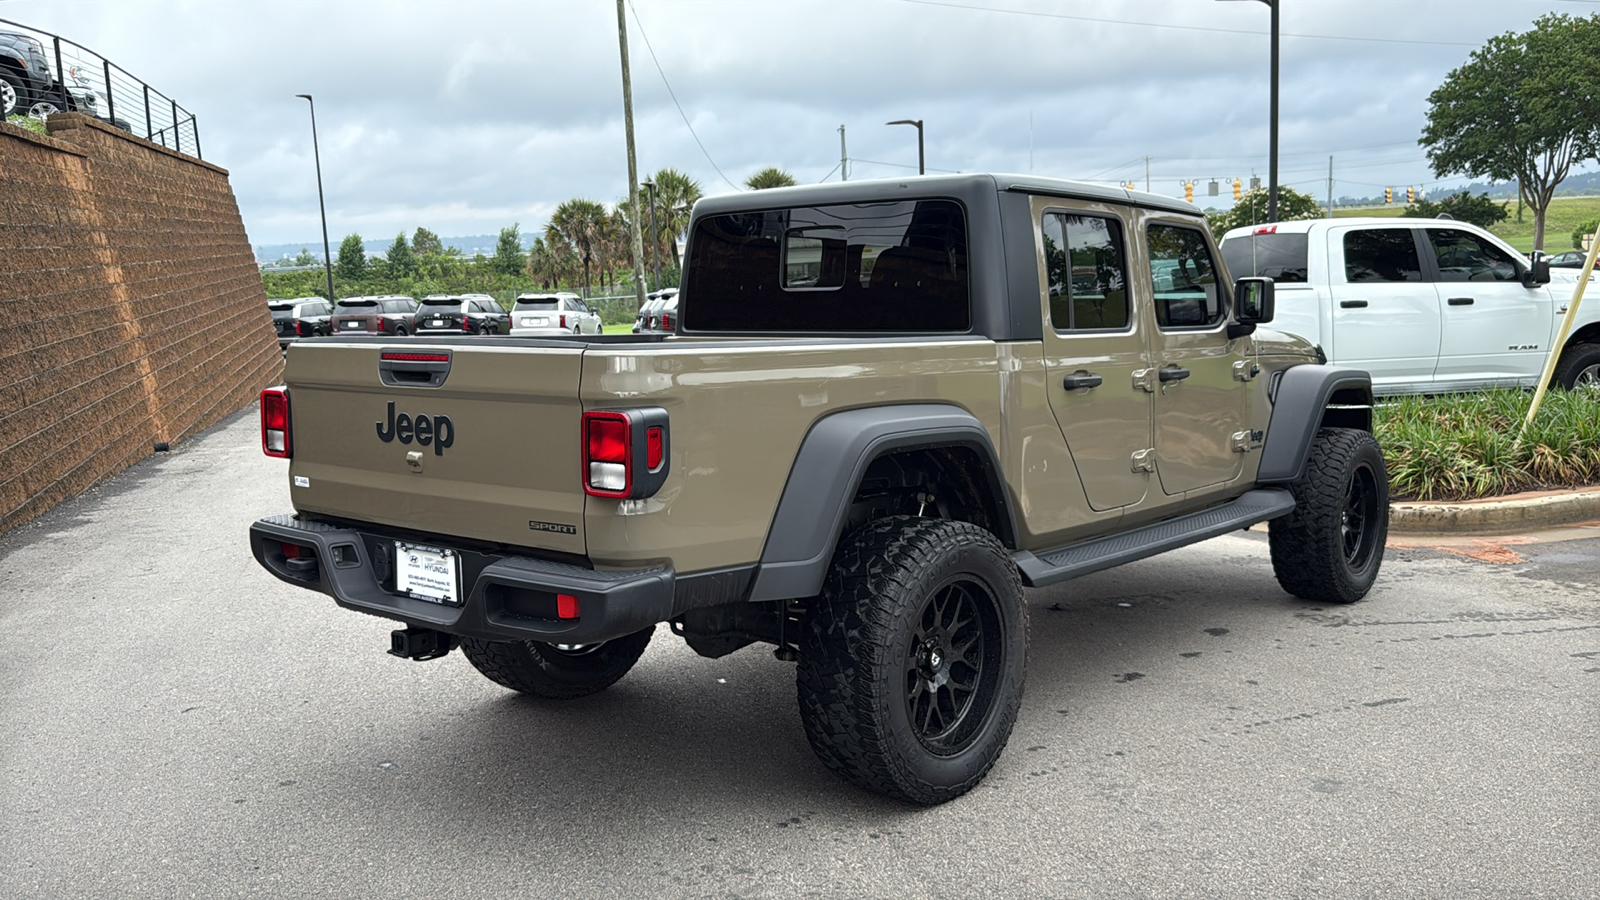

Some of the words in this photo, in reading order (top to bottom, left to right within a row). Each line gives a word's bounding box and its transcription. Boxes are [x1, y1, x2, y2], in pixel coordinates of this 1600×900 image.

[376, 400, 455, 456] Jeep
[529, 521, 575, 533] SPORT
[424, 563, 449, 575] HYUNDAI
